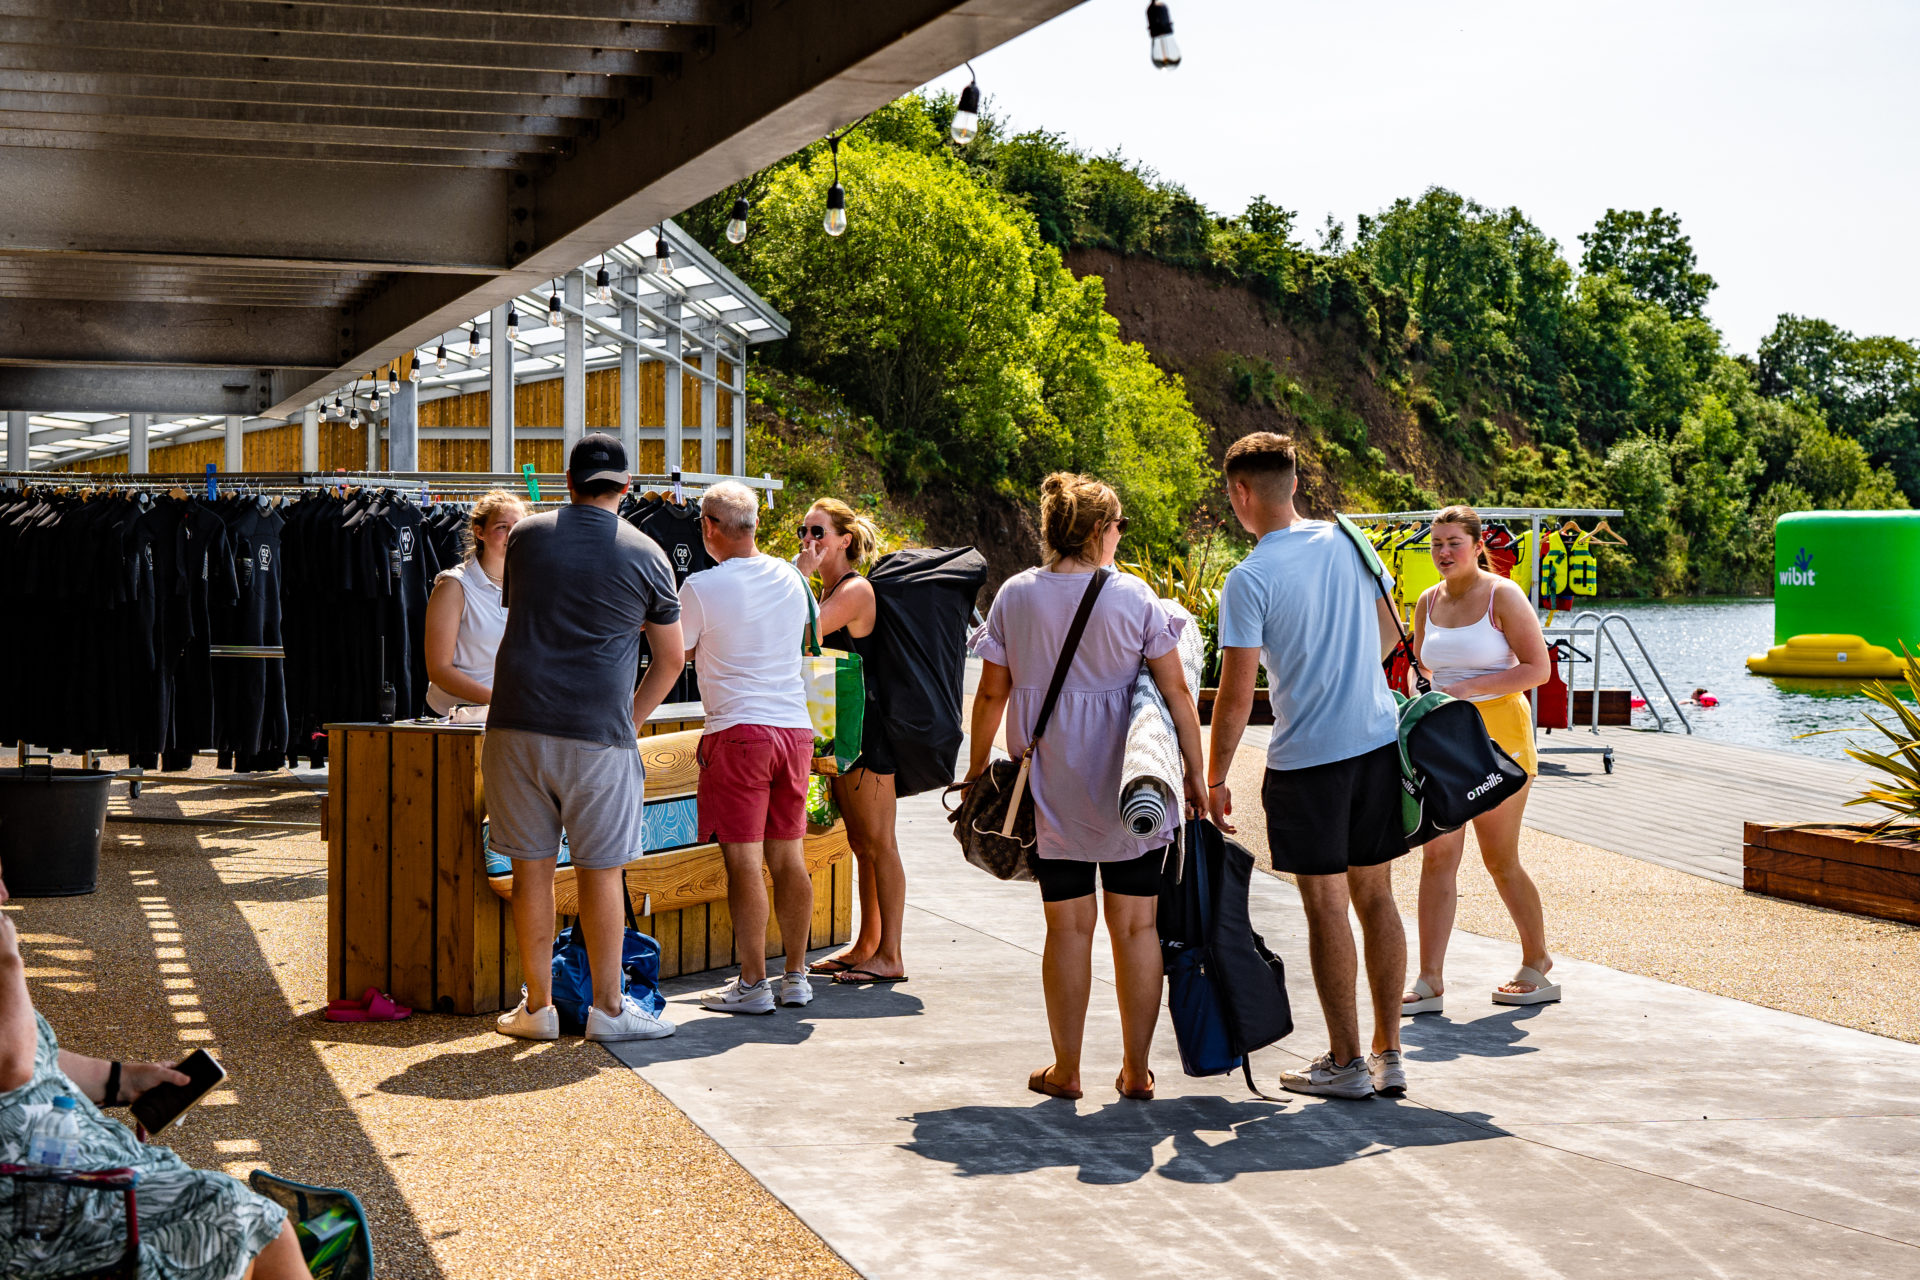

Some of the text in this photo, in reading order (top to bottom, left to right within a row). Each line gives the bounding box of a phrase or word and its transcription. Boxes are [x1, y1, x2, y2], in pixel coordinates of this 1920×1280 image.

[677, 549, 687, 557] 128
[680, 557, 685, 565] S
[1779, 567, 1816, 586] wibit
